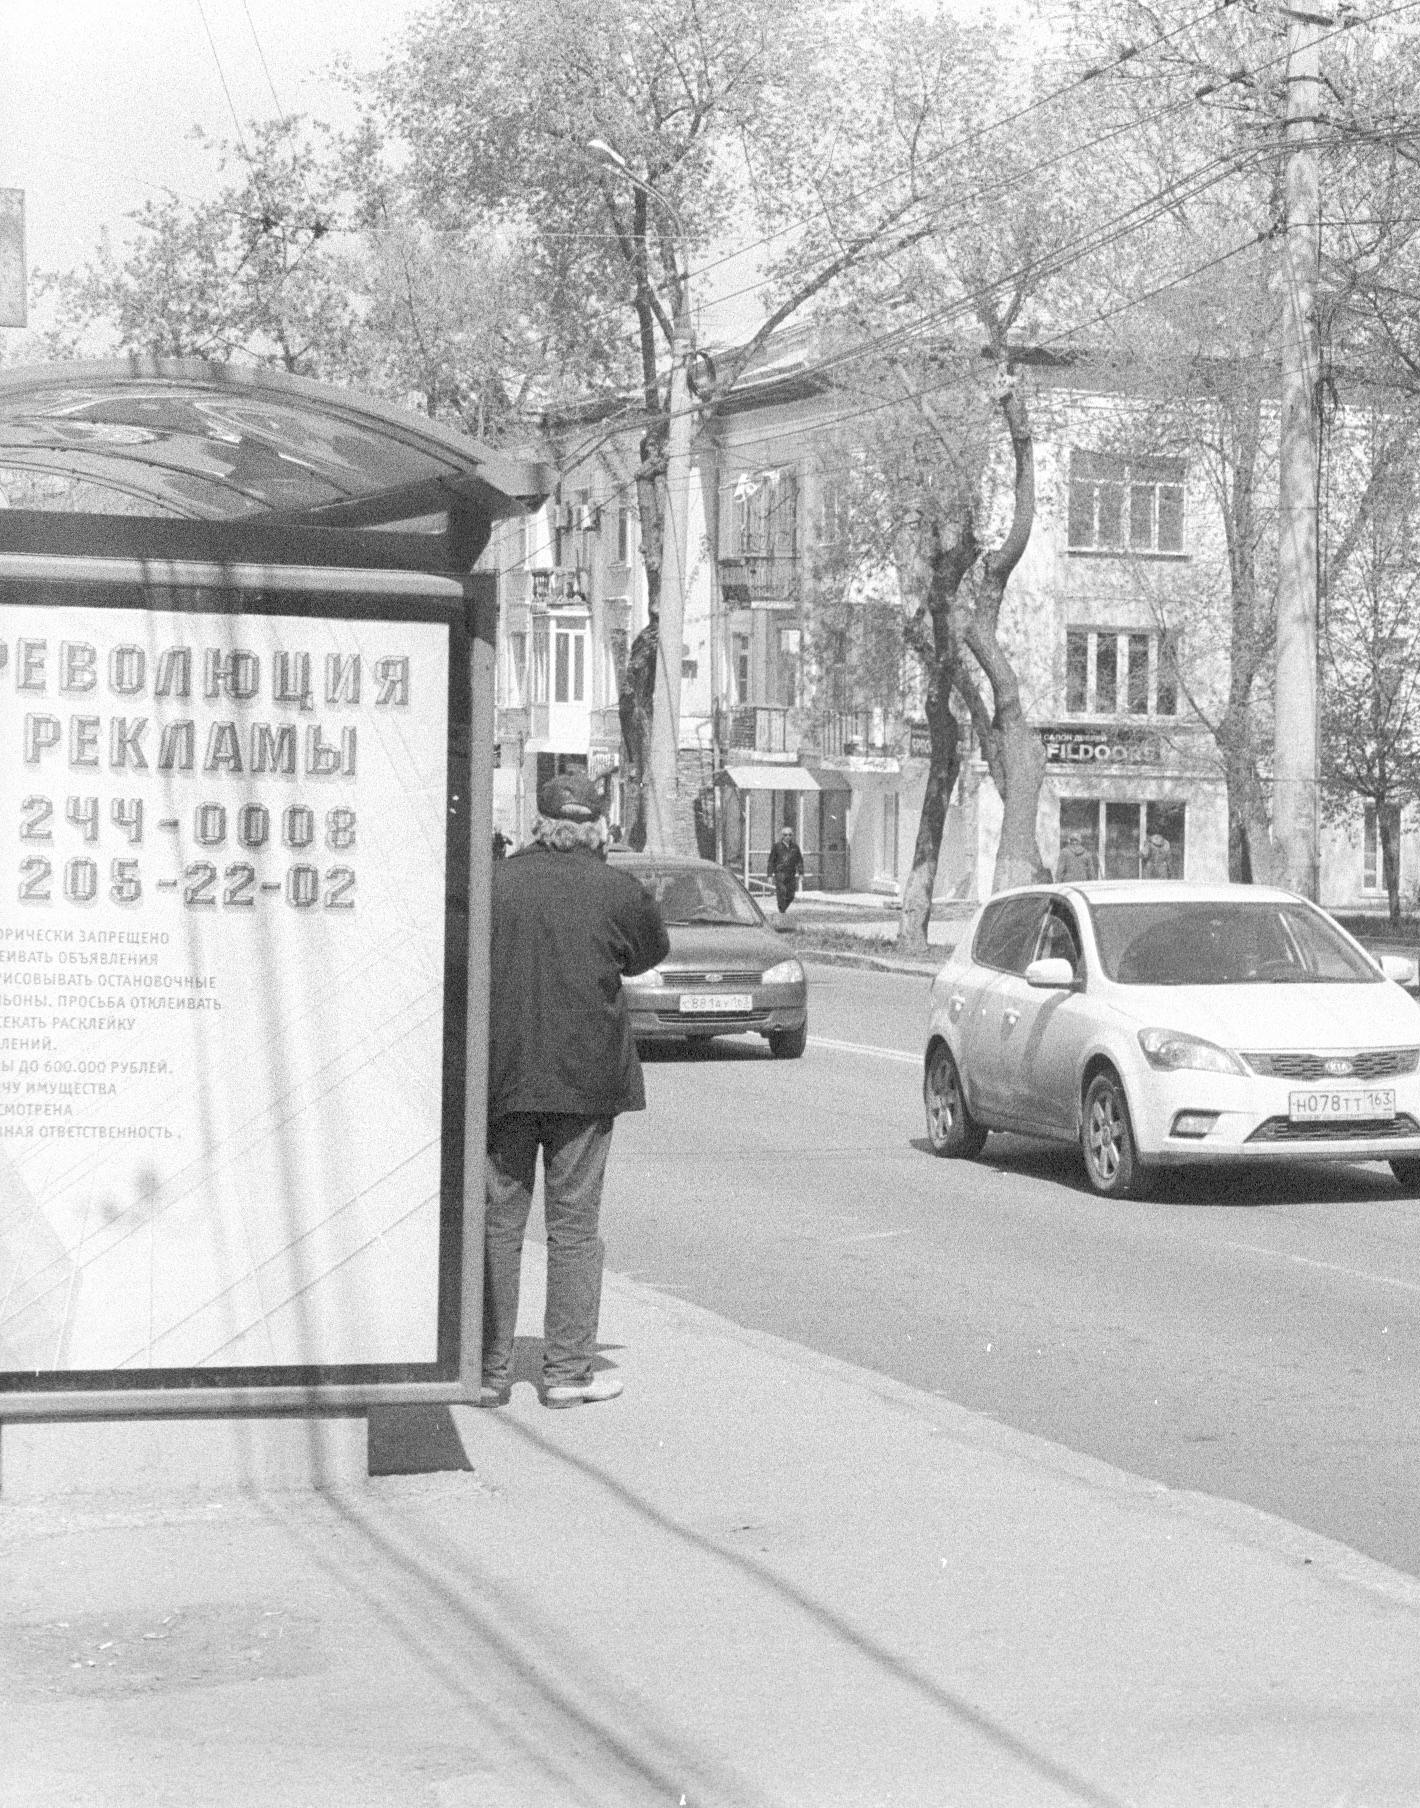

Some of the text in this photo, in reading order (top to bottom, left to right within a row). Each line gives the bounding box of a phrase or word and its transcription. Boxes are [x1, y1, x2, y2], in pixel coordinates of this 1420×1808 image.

[0, 637, 410, 711] ЕВОЛЮЦИЯ
[23, 712, 357, 777] РЕКЛАМЫ
[19, 795, 357, 850] 244-0008
[18, 855, 356, 909] 205-22-02
[79, 930, 170, 944] ЗАПРЕЩЕНО
[59, 952, 159, 965] ОБЪЯВЛЕНИЯ
[0, 972, 217, 989] ИСОВЫВАТЬ ОСТАНОВОЧНЫЕ
[58, 995, 126, 1008] ПРОСЬБА
[130, 997, 222, 1010] ОТКЛЕИВАТЬ
[52, 1015, 136, 1031] РАСКЛЕЙКУ
[19, 1060, 39, 1074] ДО
[44, 1060, 106, 1073] 600.000
[26, 1082, 116, 1097] ИМУЩЕСТВА
[1367, 1091, 1391, 1106] 163
[0, 1125, 33, 1137] НАЯ
